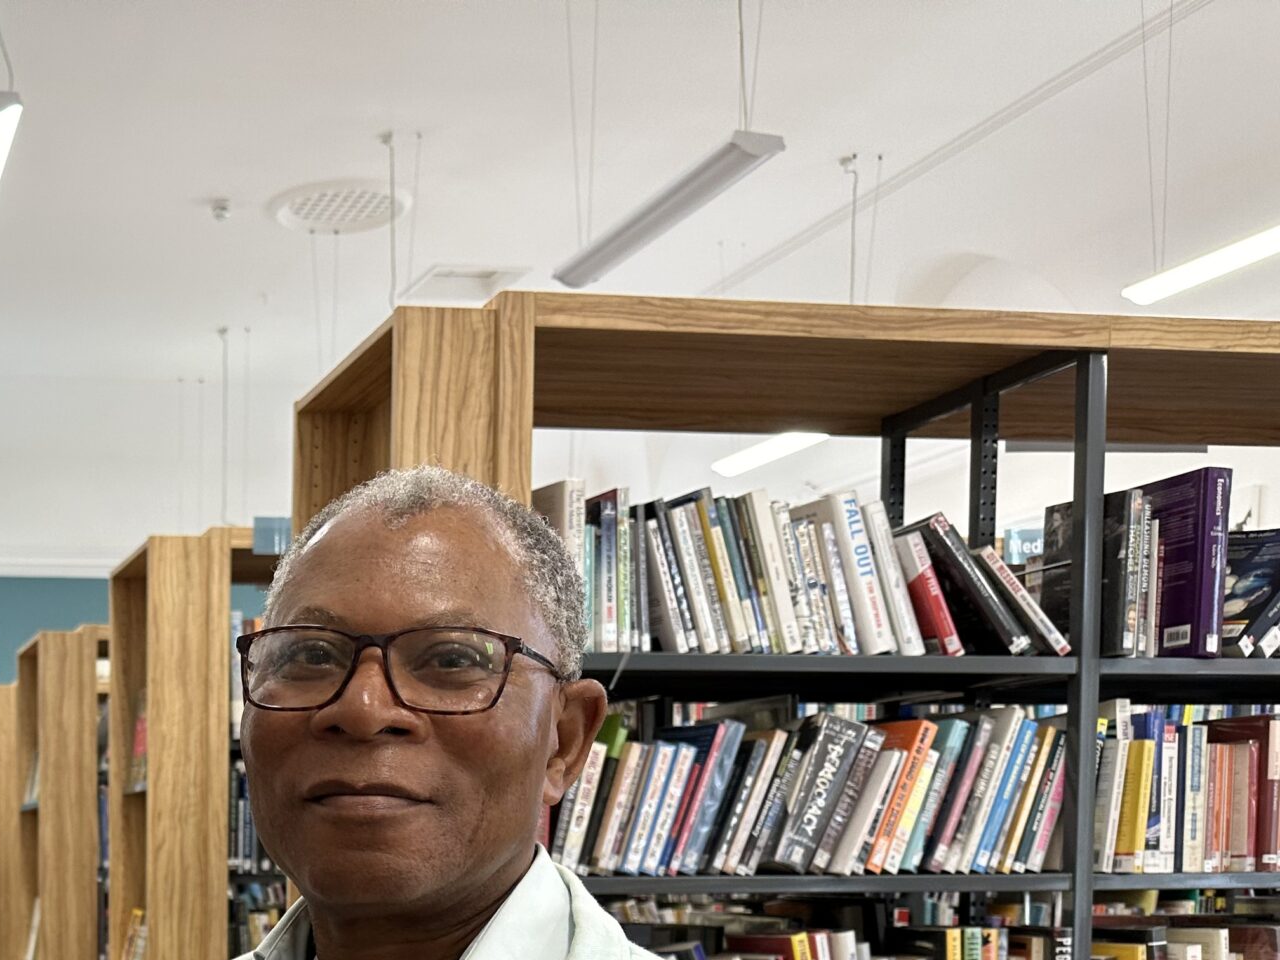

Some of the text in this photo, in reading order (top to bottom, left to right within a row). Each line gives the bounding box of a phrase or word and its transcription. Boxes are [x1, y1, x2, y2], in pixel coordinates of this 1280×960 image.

[844, 498, 859, 539] FALL
[855, 543, 874, 578] OUT
[1216, 478, 1225, 516] Economics
[1141, 504, 1152, 592] UNLEASHING DEMONS
[801, 735, 845, 836] DEMOCRACY
